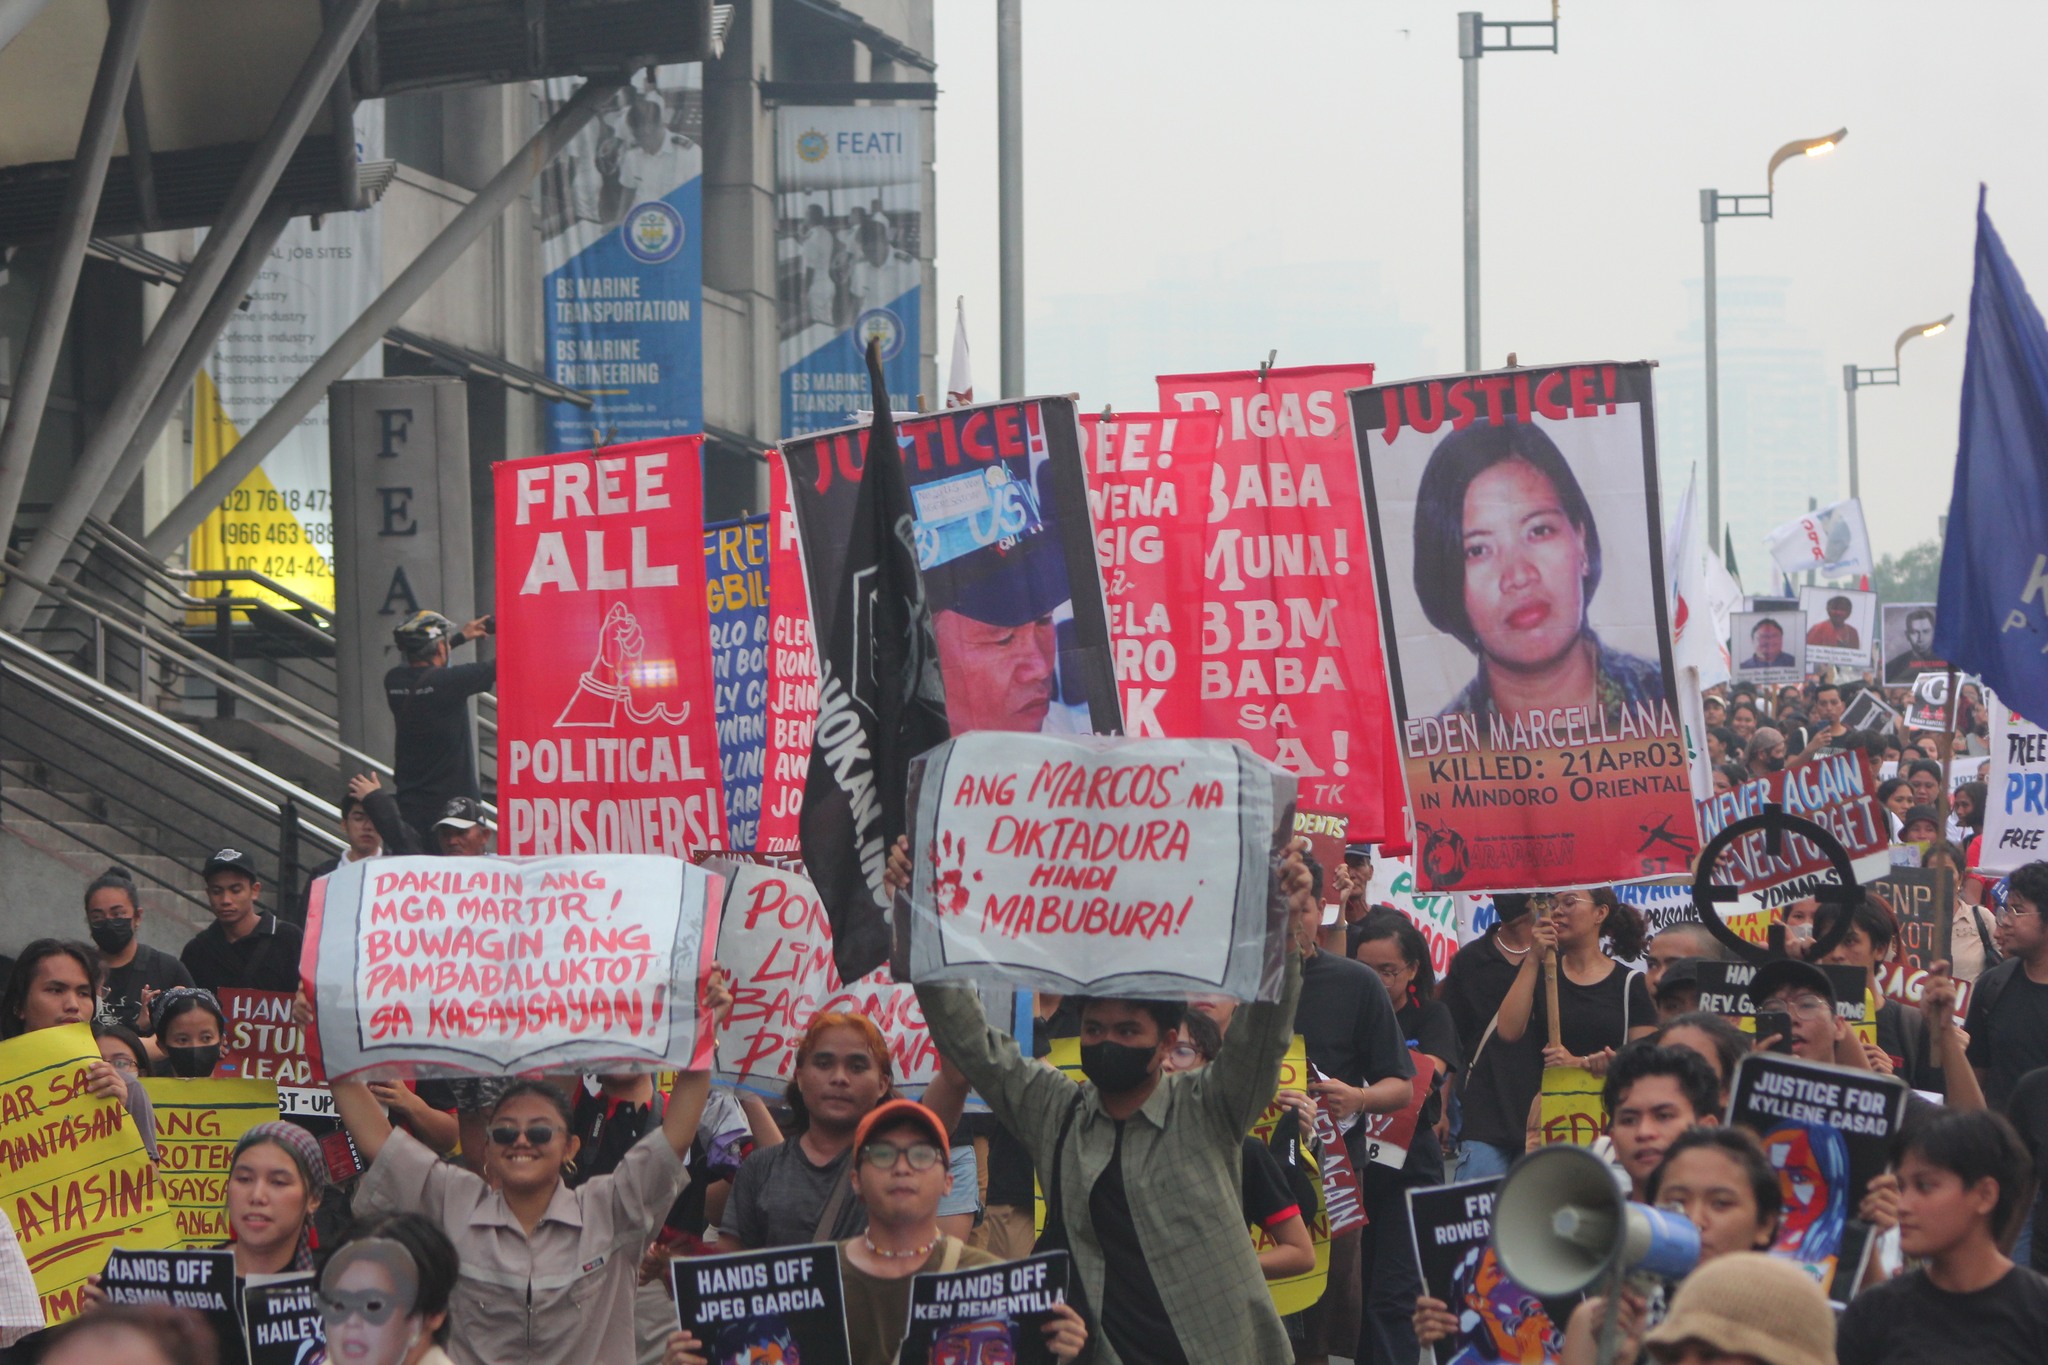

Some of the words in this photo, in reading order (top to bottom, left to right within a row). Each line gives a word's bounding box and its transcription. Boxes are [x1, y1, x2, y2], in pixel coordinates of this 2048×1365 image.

[836, 131, 901, 155] FEATI
[288, 247, 314, 262] JOB
[317, 247, 353, 259] SITES
[556, 278, 575, 299] BS
[577, 277, 641, 299] MARINE
[556, 300, 690, 323] TRANSPORTATION
[279, 352, 322, 365] industr
[556, 340, 577, 361] BS
[578, 339, 641, 361] MARINE
[556, 363, 660, 385] ENGINEERING
[791, 373, 810, 391] BS
[812, 373, 868, 391] MARINE
[1381, 366, 1618, 446] JUSTICE!
[814, 401, 1044, 495] JUTICE!
[256, 489, 301, 511] 7618
[304, 489, 332, 511] 47
[515, 452, 673, 526] FREE
[266, 523, 299, 544] 463
[519, 526, 680, 595] ALL
[1205, 529, 1350, 591] MUNA!
[1201, 598, 1342, 655] BBM
[1200, 656, 1347, 700] BABA
[1237, 702, 1298, 730] SA
[1404, 711, 1481, 759] EDEN
[1489, 698, 1680, 752] MARCELLANA
[509, 735, 706, 785] POLITICAL
[1428, 755, 1546, 784] KILLED:
[954, 773, 1018, 808] ANG
[1187, 779, 1224, 810] NA
[1783, 751, 1865, 815] AGAIN
[509, 786, 724, 857] PRISONERS!
[986, 815, 1191, 863] DIKTADURA
[1999, 827, 2045, 850] FREE
[374, 870, 523, 898] DAKILAIN
[541, 870, 607, 891] ANG
[1029, 864, 1118, 892] HINDI
[1641, 857, 1669, 875] ST
[371, 895, 446, 926] MGA
[981, 894, 1194, 941] MABUBURA!
[364, 926, 543, 965] BUWAGIN
[564, 924, 652, 953] ANG
[365, 953, 662, 1000] PAMBABALUKTOT
[370, 1004, 413, 1041] SA
[427, 984, 667, 1040] KASAYSAYAN!
[1699, 992, 1736, 1014] REV.
[1748, 1093, 1827, 1125] KYLLENE
[1753, 1071, 1842, 1108] JUSTICE
[1844, 1086, 1887, 1116] FOR
[16, 1163, 154, 1244] AYASIN!
[108, 1256, 171, 1283] HANDS
[176, 1259, 213, 1285] OFF
[696, 1263, 769, 1296] HANDS
[774, 1257, 814, 1286] OFF
[935, 1272, 1005, 1302] HANDS
[1010, 1262, 1048, 1293] OFF
[695, 1297, 746, 1324] JPEG
[751, 1287, 826, 1317] GARCIA
[914, 1302, 953, 1320] KEN
[957, 1287, 1066, 1318] REMENTILLA
